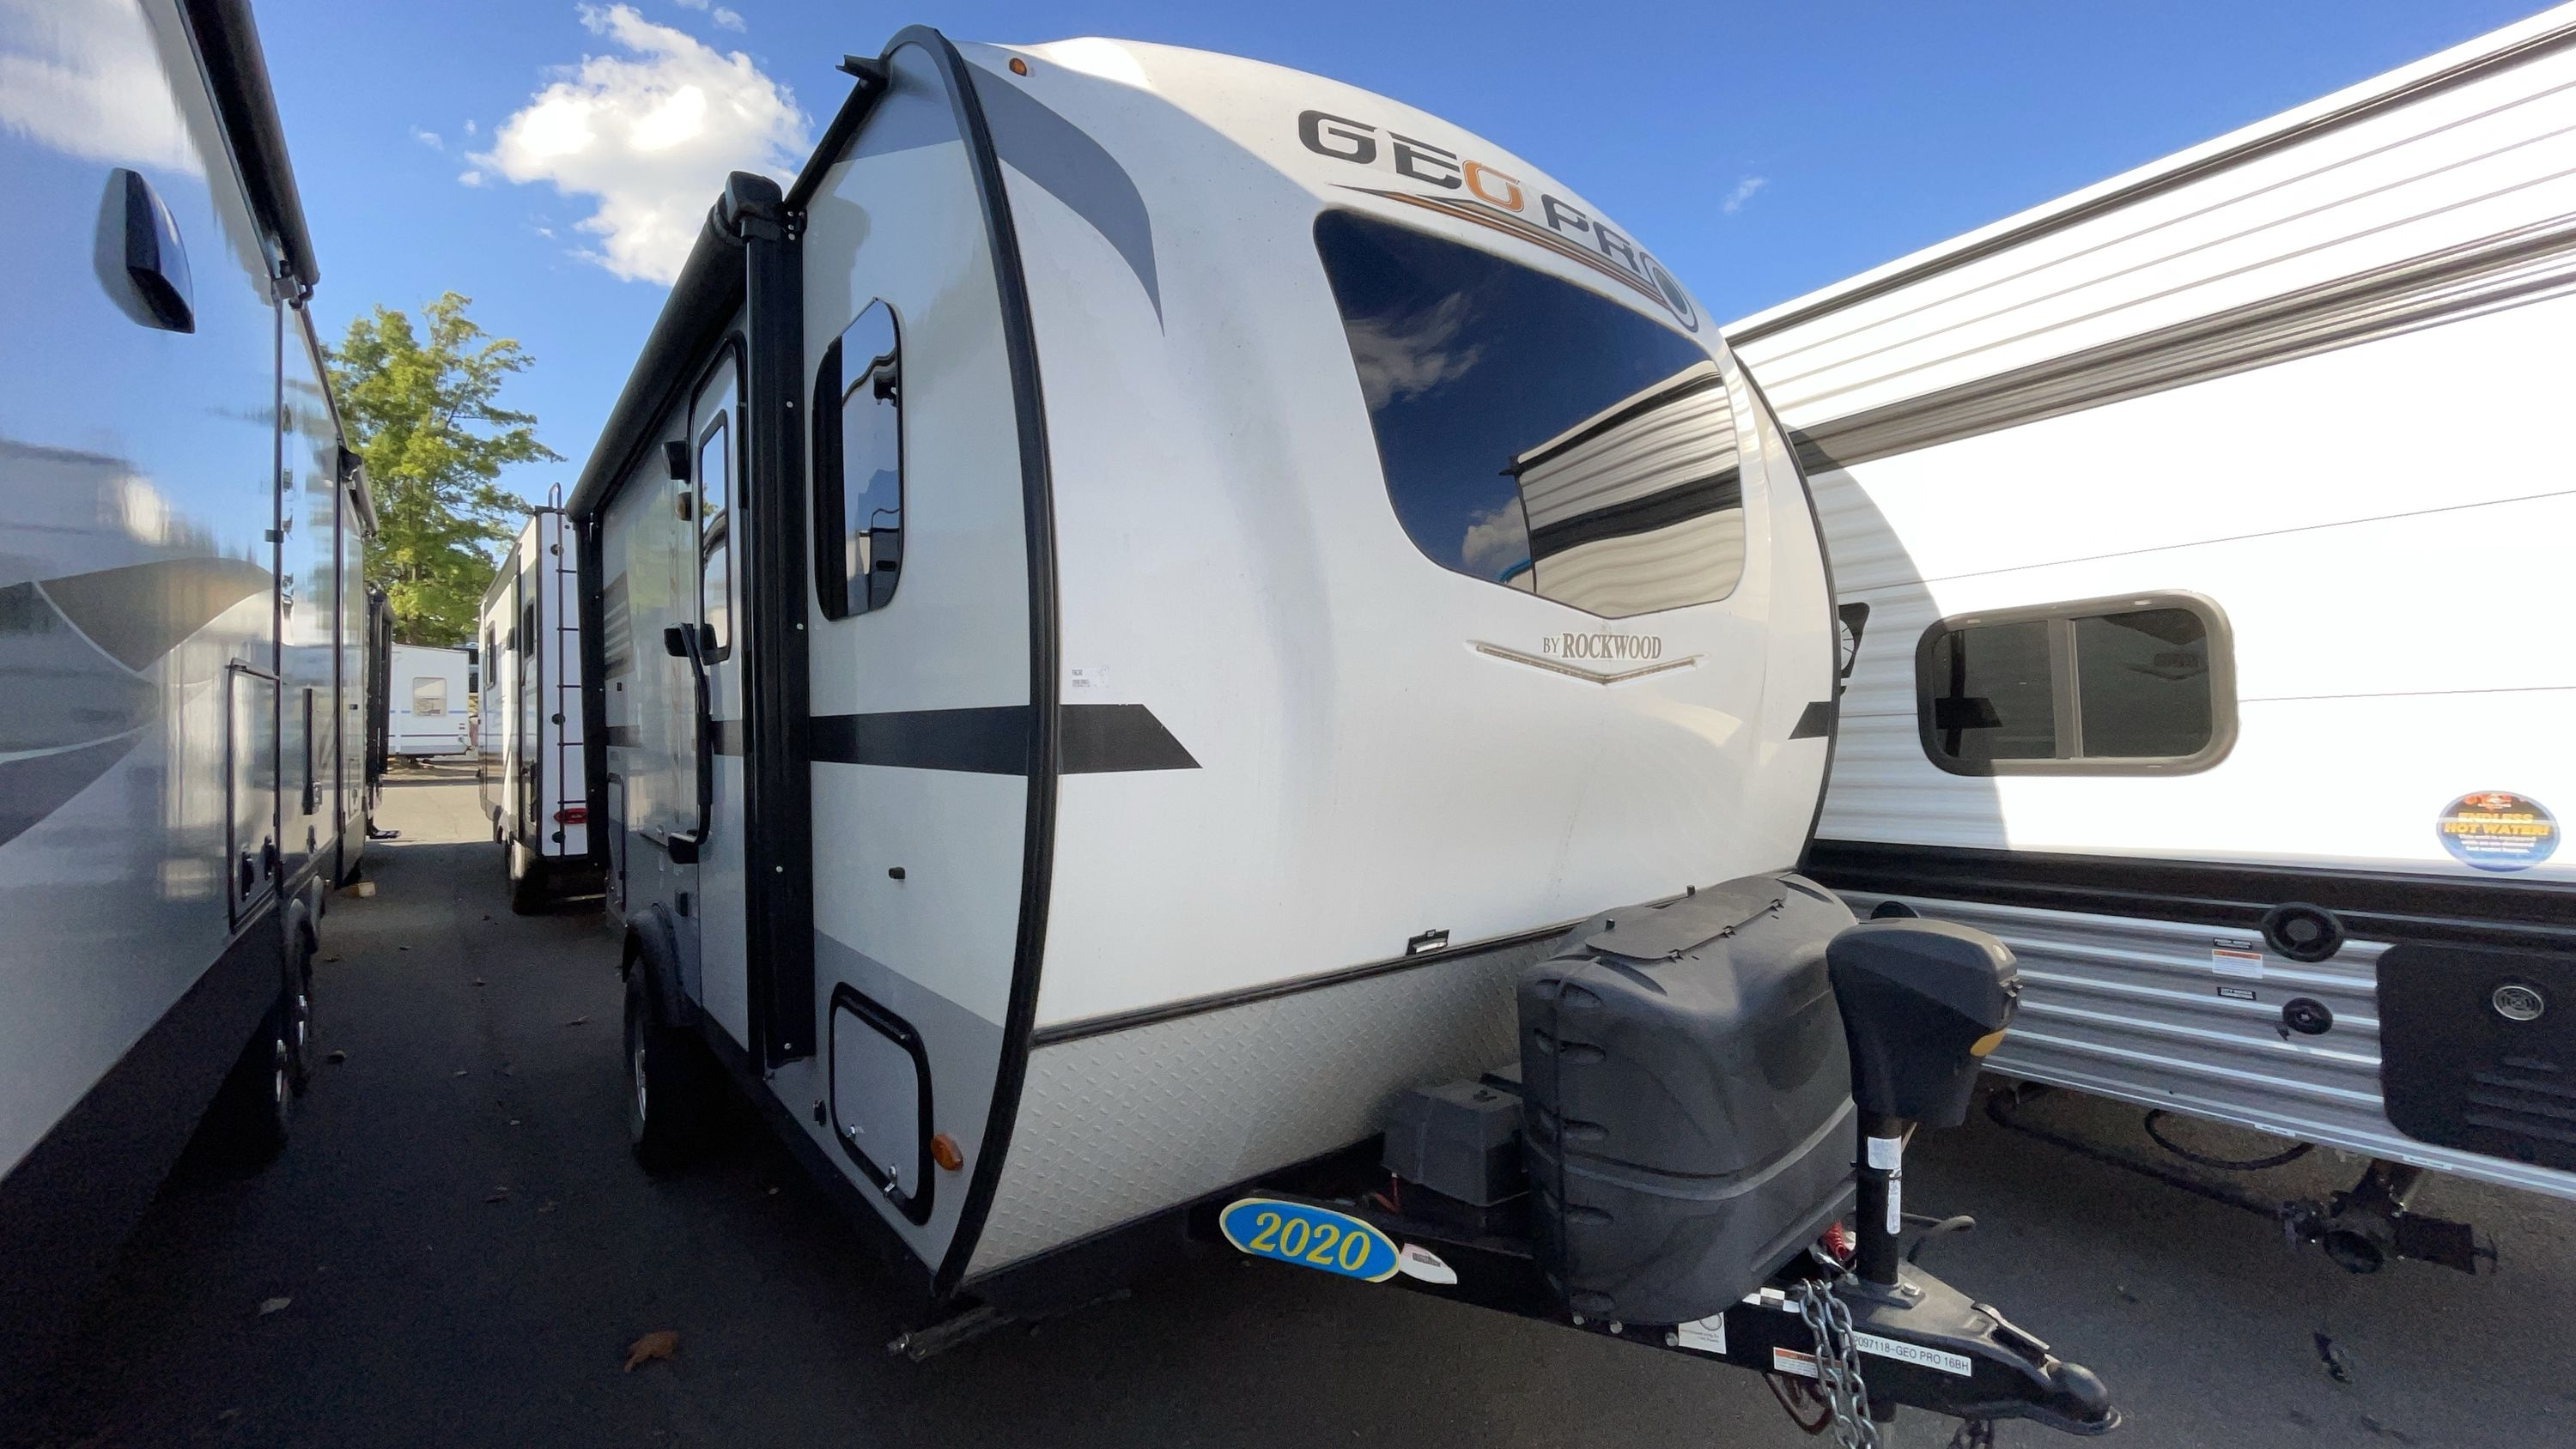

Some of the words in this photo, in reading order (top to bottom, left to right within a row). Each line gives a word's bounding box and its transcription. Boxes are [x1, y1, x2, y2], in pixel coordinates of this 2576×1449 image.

[1298, 109, 1525, 213] GEO
[1541, 194, 1698, 333] PRO
[1543, 637, 1560, 653] BY
[1561, 633, 1662, 659] ROCKWOOD
[2444, 822, 2481, 834] HOT
[1249, 1211, 1370, 1271] 2020
[1919, 1350, 1941, 1365] PRO
[1944, 1356, 1969, 1372] 16BH
